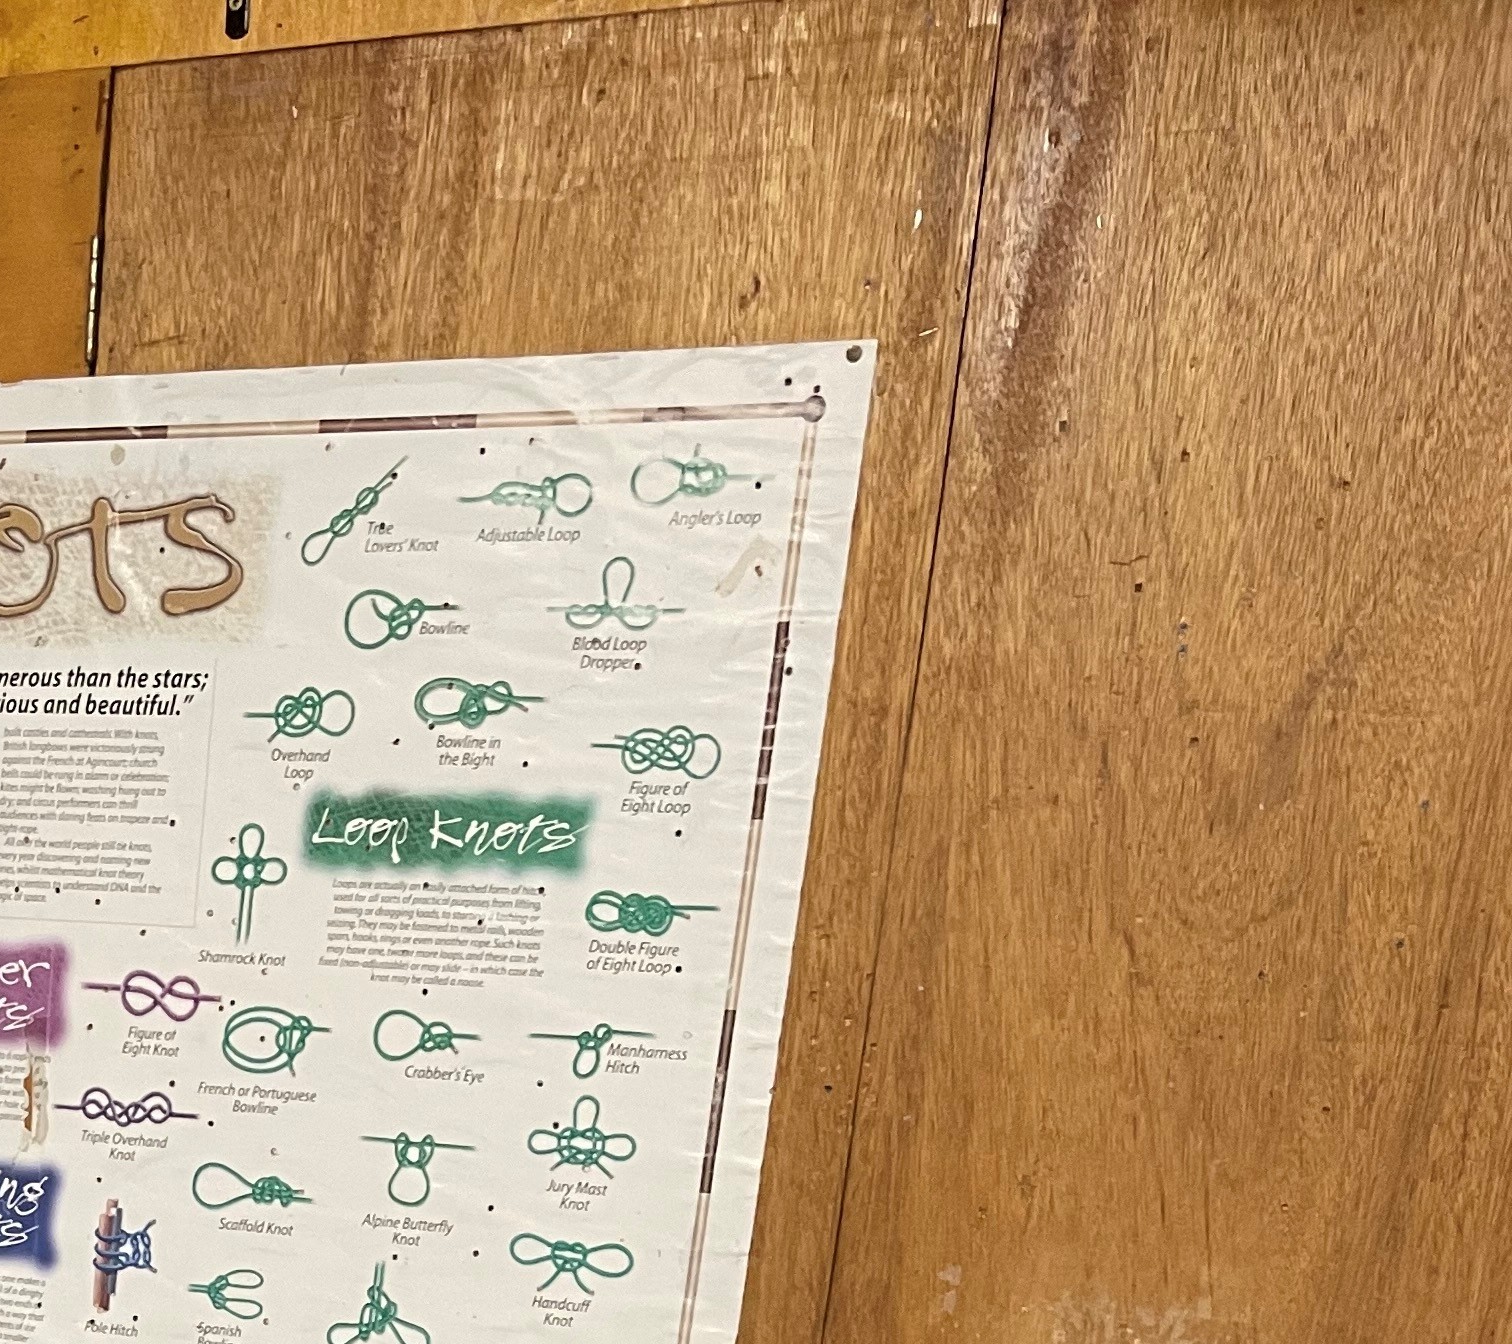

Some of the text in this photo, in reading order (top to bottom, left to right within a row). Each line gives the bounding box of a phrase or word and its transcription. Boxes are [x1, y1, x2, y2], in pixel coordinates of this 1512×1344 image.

[669, 511, 761, 527] Angler's Loop
[476, 527, 580, 544] Adjustable Loop
[410, 538, 438, 552] Knot
[420, 621, 470, 636] Bowline
[613, 636, 647, 653] Loop
[580, 654, 634, 671] Dropper
[67, 668, 112, 688] than
[117, 669, 149, 688] the
[153, 672, 208, 692] stars;
[43, 694, 82, 714] and
[436, 734, 501, 750] Bowline in
[271, 749, 331, 763] Overhand
[439, 752, 495, 768] the Bight
[284, 765, 314, 781] Loop
[629, 782, 688, 799] Figure of
[621, 798, 690, 816] Eight Loop
[312, 809, 588, 863] Loop Knots
[589, 940, 681, 958] Double Figure
[198, 950, 285, 967] Shamrock Knot
[586, 958, 671, 976] of Eight Loop
[129, 1027, 176, 1043] Figure of
[122, 1042, 178, 1058] Eight Knot
[405, 1065, 485, 1085] Crabber's Eye
[606, 1060, 640, 1075] Hitch
[197, 1083, 316, 1103] French or Portuguese
[233, 1102, 278, 1116] Bowline
[81, 1130, 168, 1149] Triple Overhand
[109, 1148, 135, 1161] Knot
[546, 1180, 607, 1197] Jury Mast
[559, 1197, 589, 1210] Knot
[219, 1218, 294, 1236] Scaffold Knot
[362, 1214, 453, 1236] Alpine Butterfly
[392, 1232, 420, 1247] Knot
[532, 1296, 590, 1314] Handcuff
[544, 1313, 574, 1328] Knot
[111, 1324, 138, 1338] Hitch
[196, 1323, 242, 1341] Spanish
